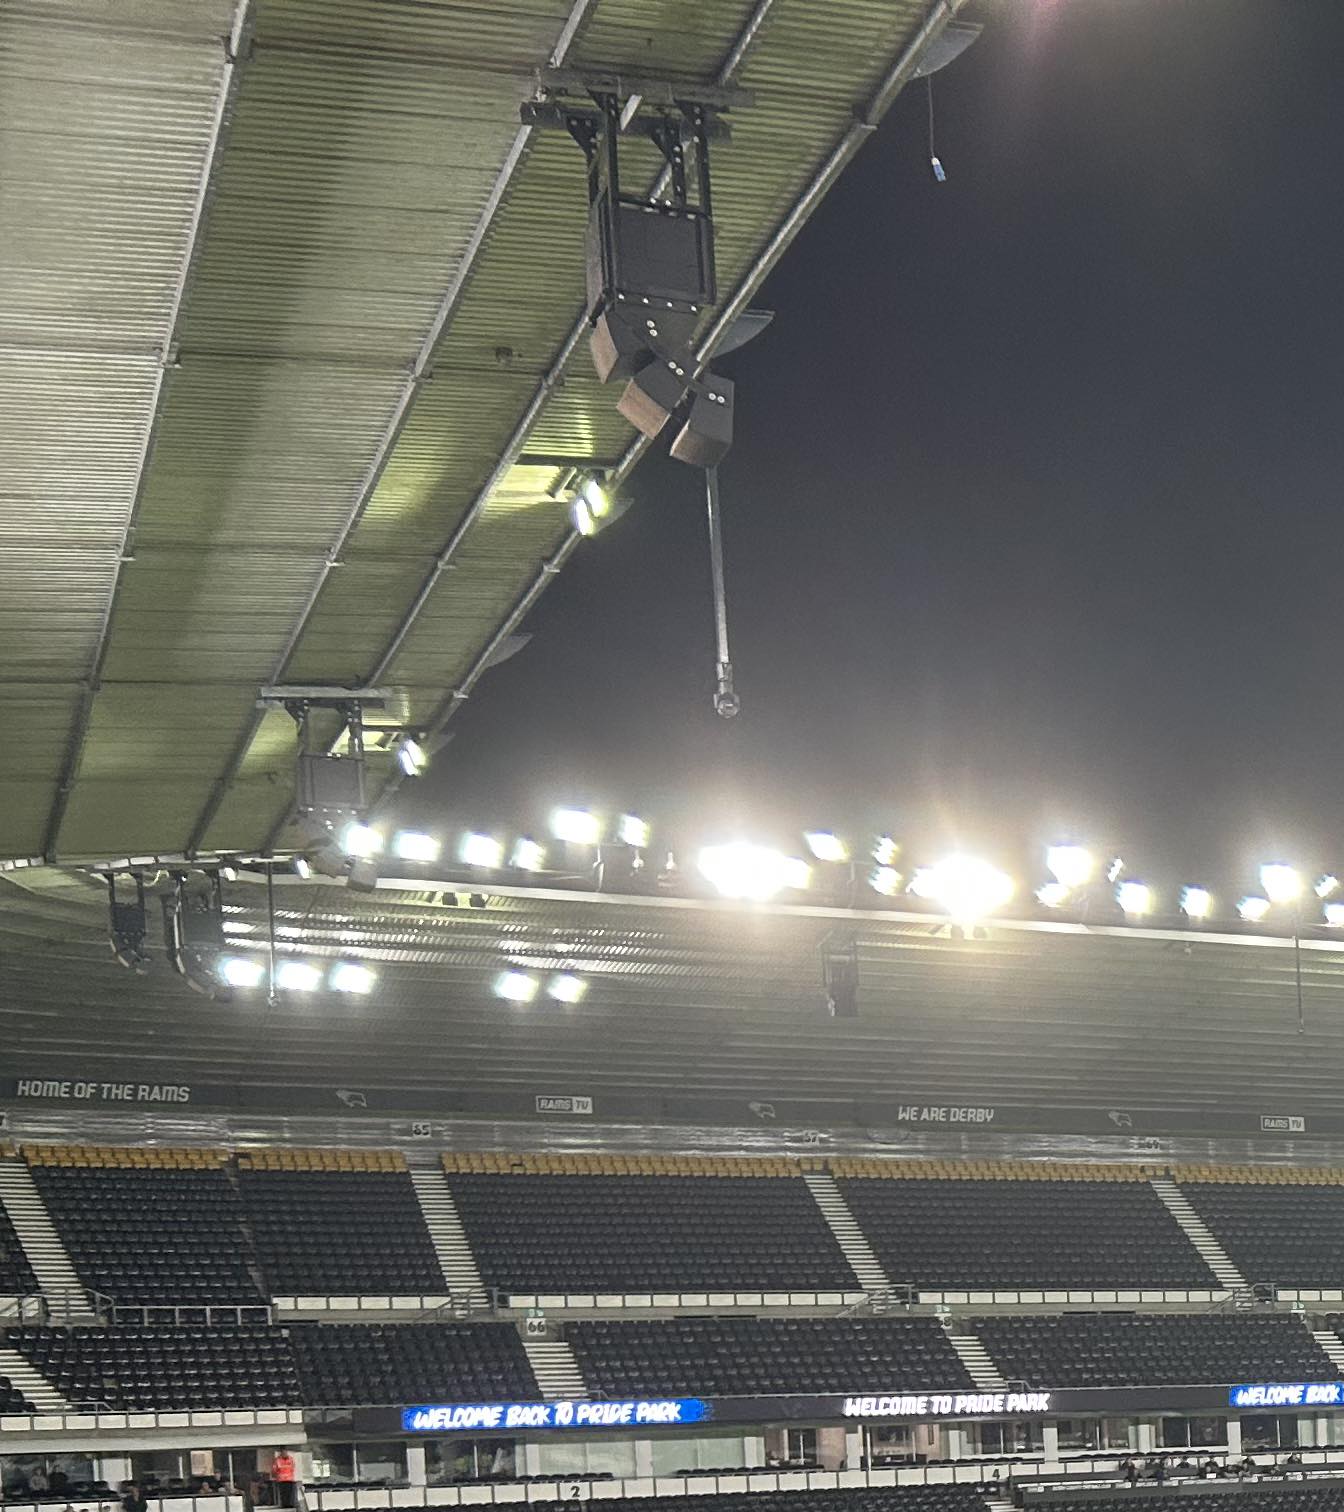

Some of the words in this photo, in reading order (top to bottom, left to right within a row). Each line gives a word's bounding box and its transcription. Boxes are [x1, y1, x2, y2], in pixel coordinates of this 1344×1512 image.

[18, 1081, 71, 1098] HOME
[74, 1083, 97, 1099] OF
[101, 1084, 134, 1100] THE
[138, 1085, 190, 1102] RAMS
[898, 1106, 917, 1121] WE
[920, 1107, 946, 1122] ARE
[949, 1108, 994, 1122] DERBY
[528, 1321, 545, 1333] 66
[1236, 1385, 1304, 1405] WELCOME
[1305, 1384, 1339, 1403] BACK
[844, 1396, 927, 1416] WELCOME
[928, 1396, 953, 1415] TO
[955, 1394, 1005, 1414] PRIDE
[1007, 1393, 1050, 1412] PARK
[413, 1406, 503, 1429] WELCOME
[500, 1406, 550, 1427] BACK
[554, 1401, 573, 1426] TO
[576, 1402, 632, 1424] PRIDE
[635, 1401, 681, 1423] PARK
[992, 1469, 1000, 1480] 4
[571, 1486, 580, 1497] 2
